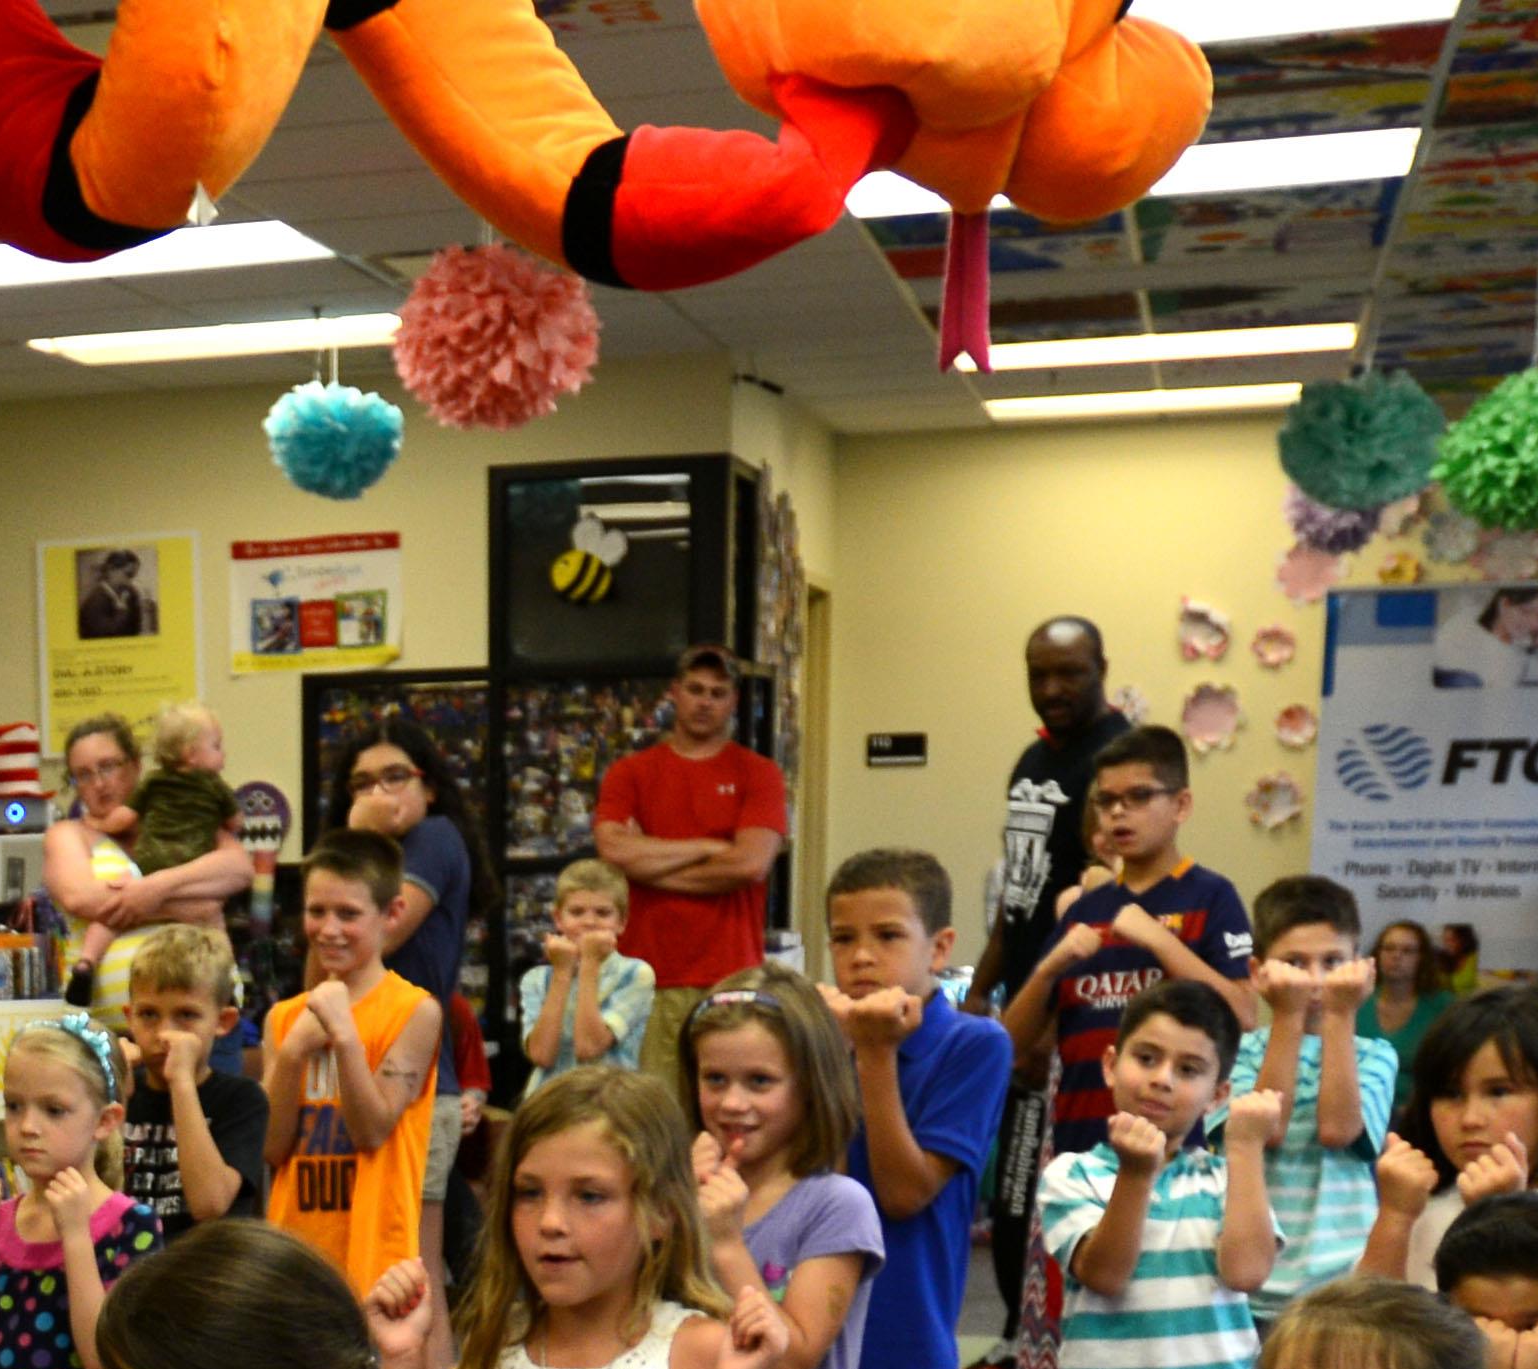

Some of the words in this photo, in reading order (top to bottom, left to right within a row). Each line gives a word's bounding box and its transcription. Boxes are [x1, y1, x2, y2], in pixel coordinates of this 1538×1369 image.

[1344, 860, 1391, 875] Phone
[1406, 859, 1456, 877] Digital
[1461, 859, 1482, 874] TV
[1376, 884, 1441, 901] Security
[1455, 883, 1521, 898] Wireless
